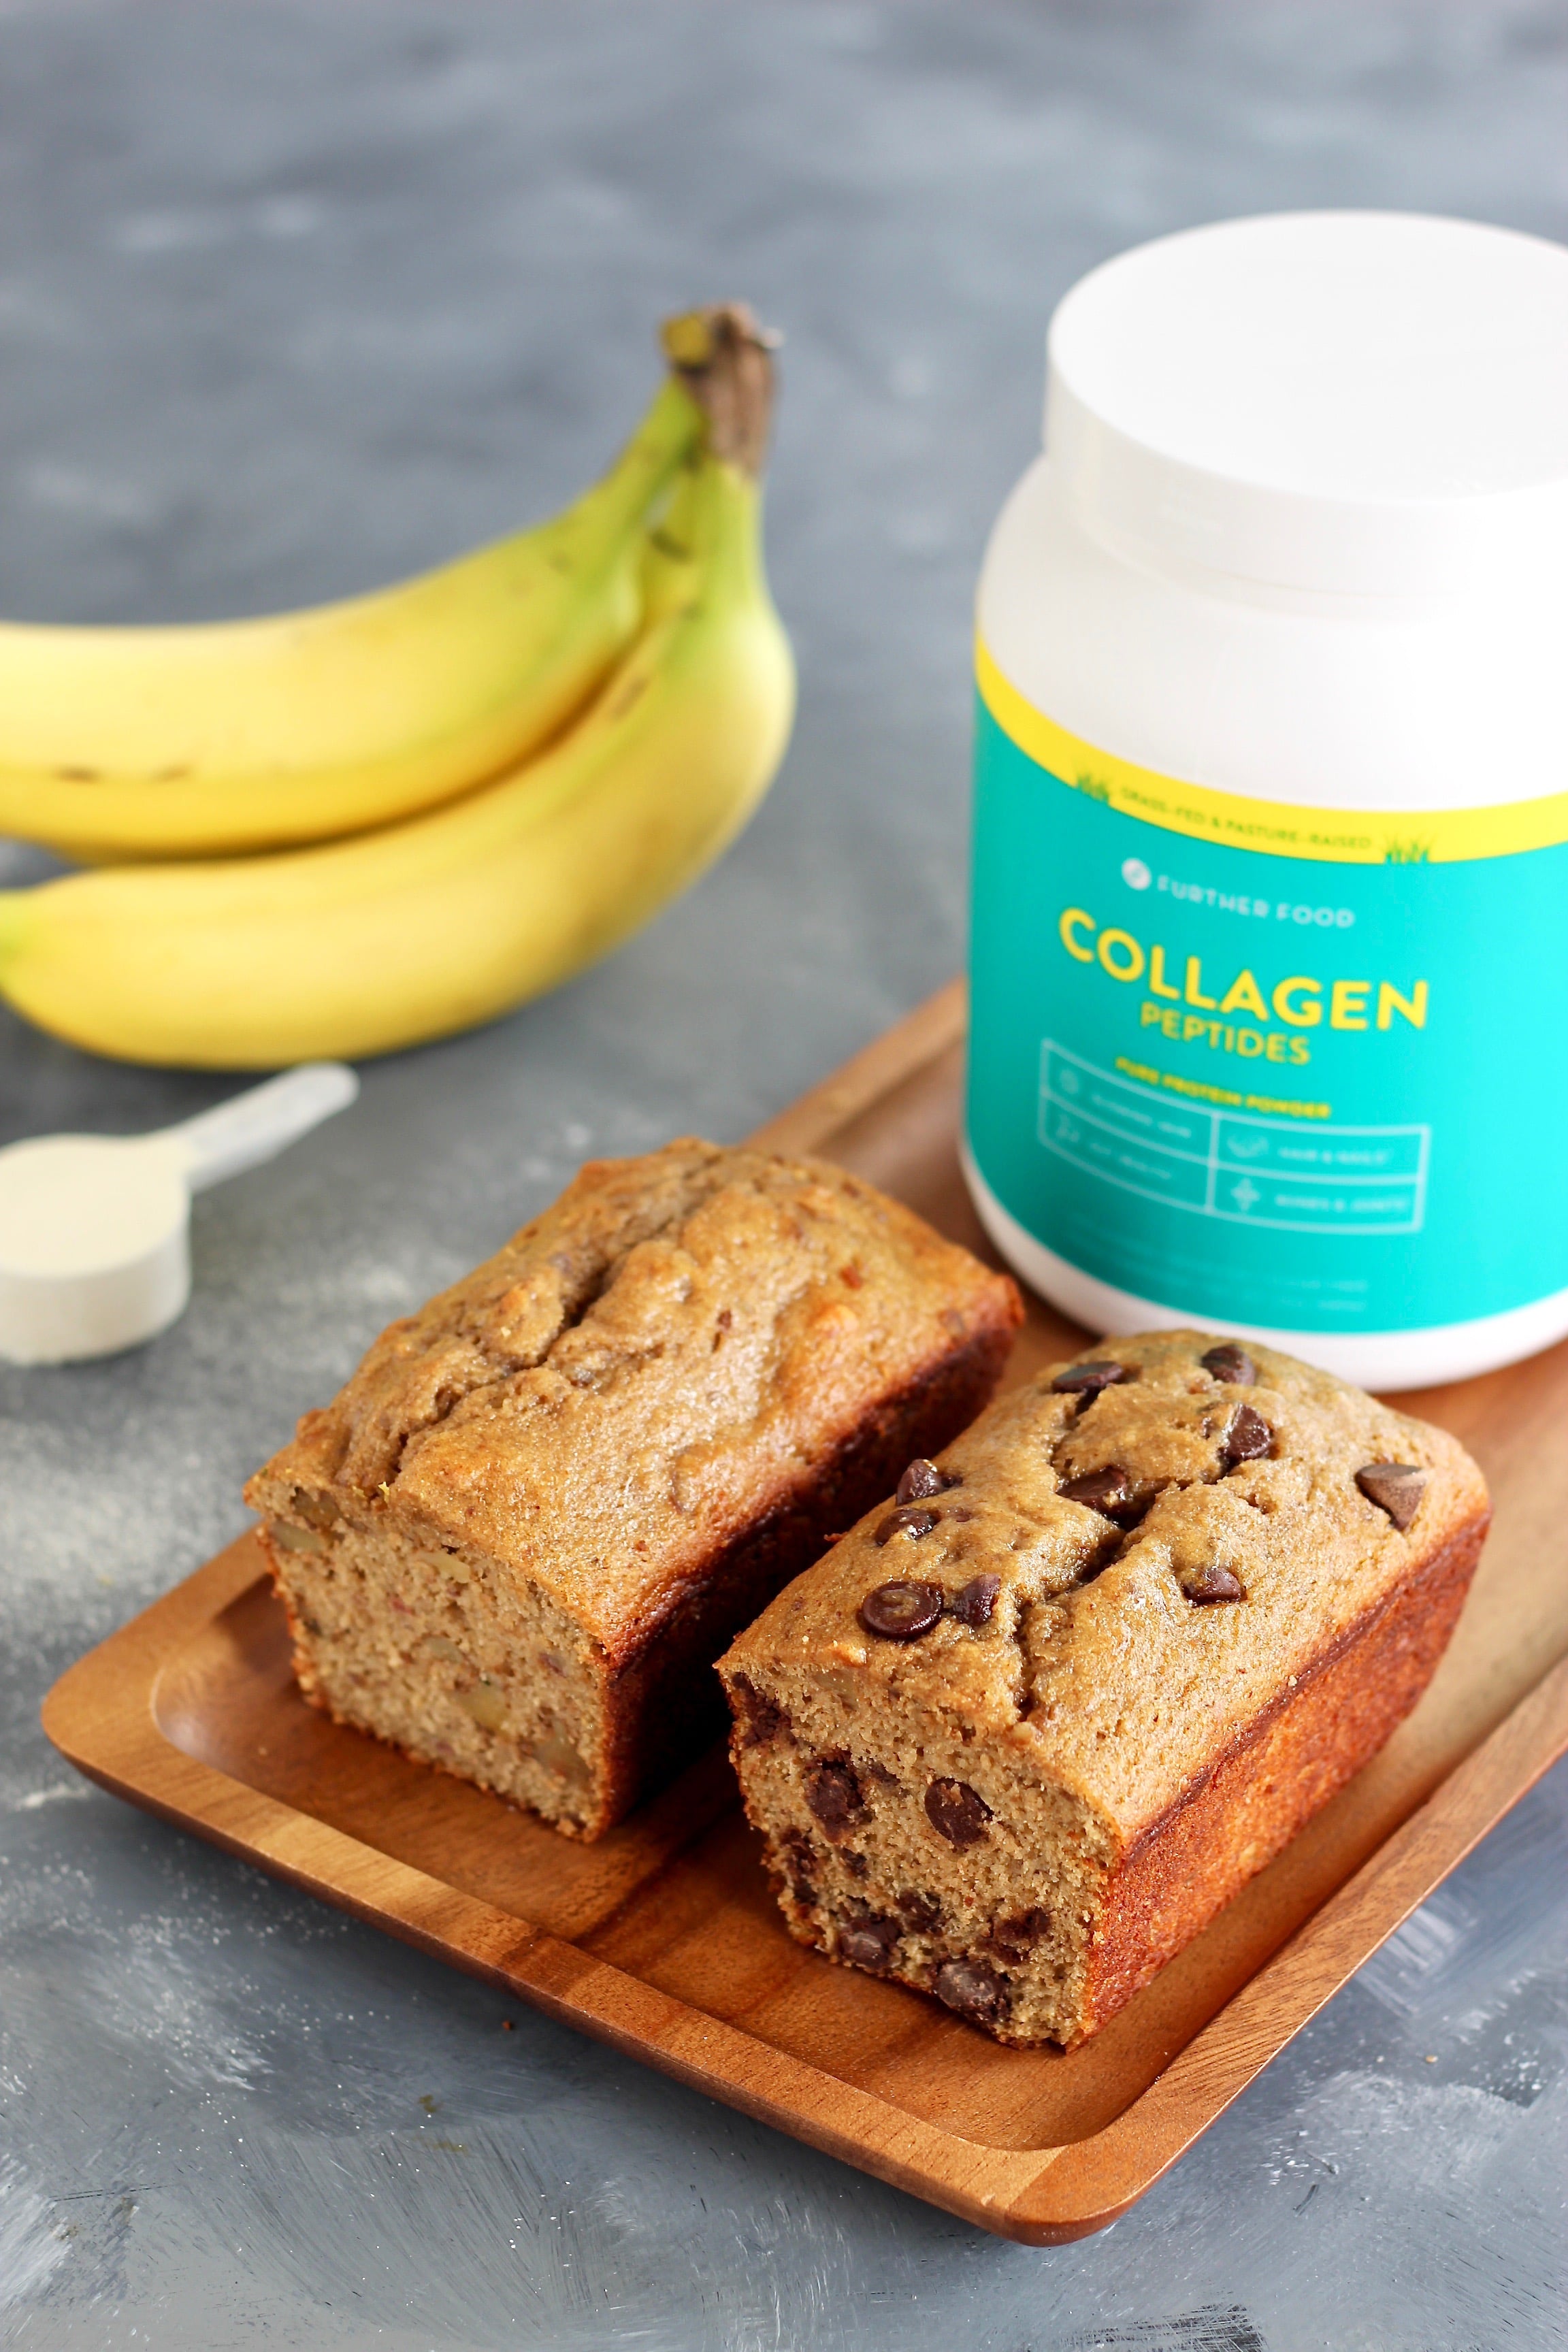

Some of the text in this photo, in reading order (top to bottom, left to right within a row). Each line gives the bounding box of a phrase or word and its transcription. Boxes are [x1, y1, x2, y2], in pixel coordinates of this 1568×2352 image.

[1158, 875, 1356, 928] FURTHER FOOD
[1059, 907, 1428, 1030] COLLAGEN
[1141, 1001, 1311, 1065] PEPTIDES
